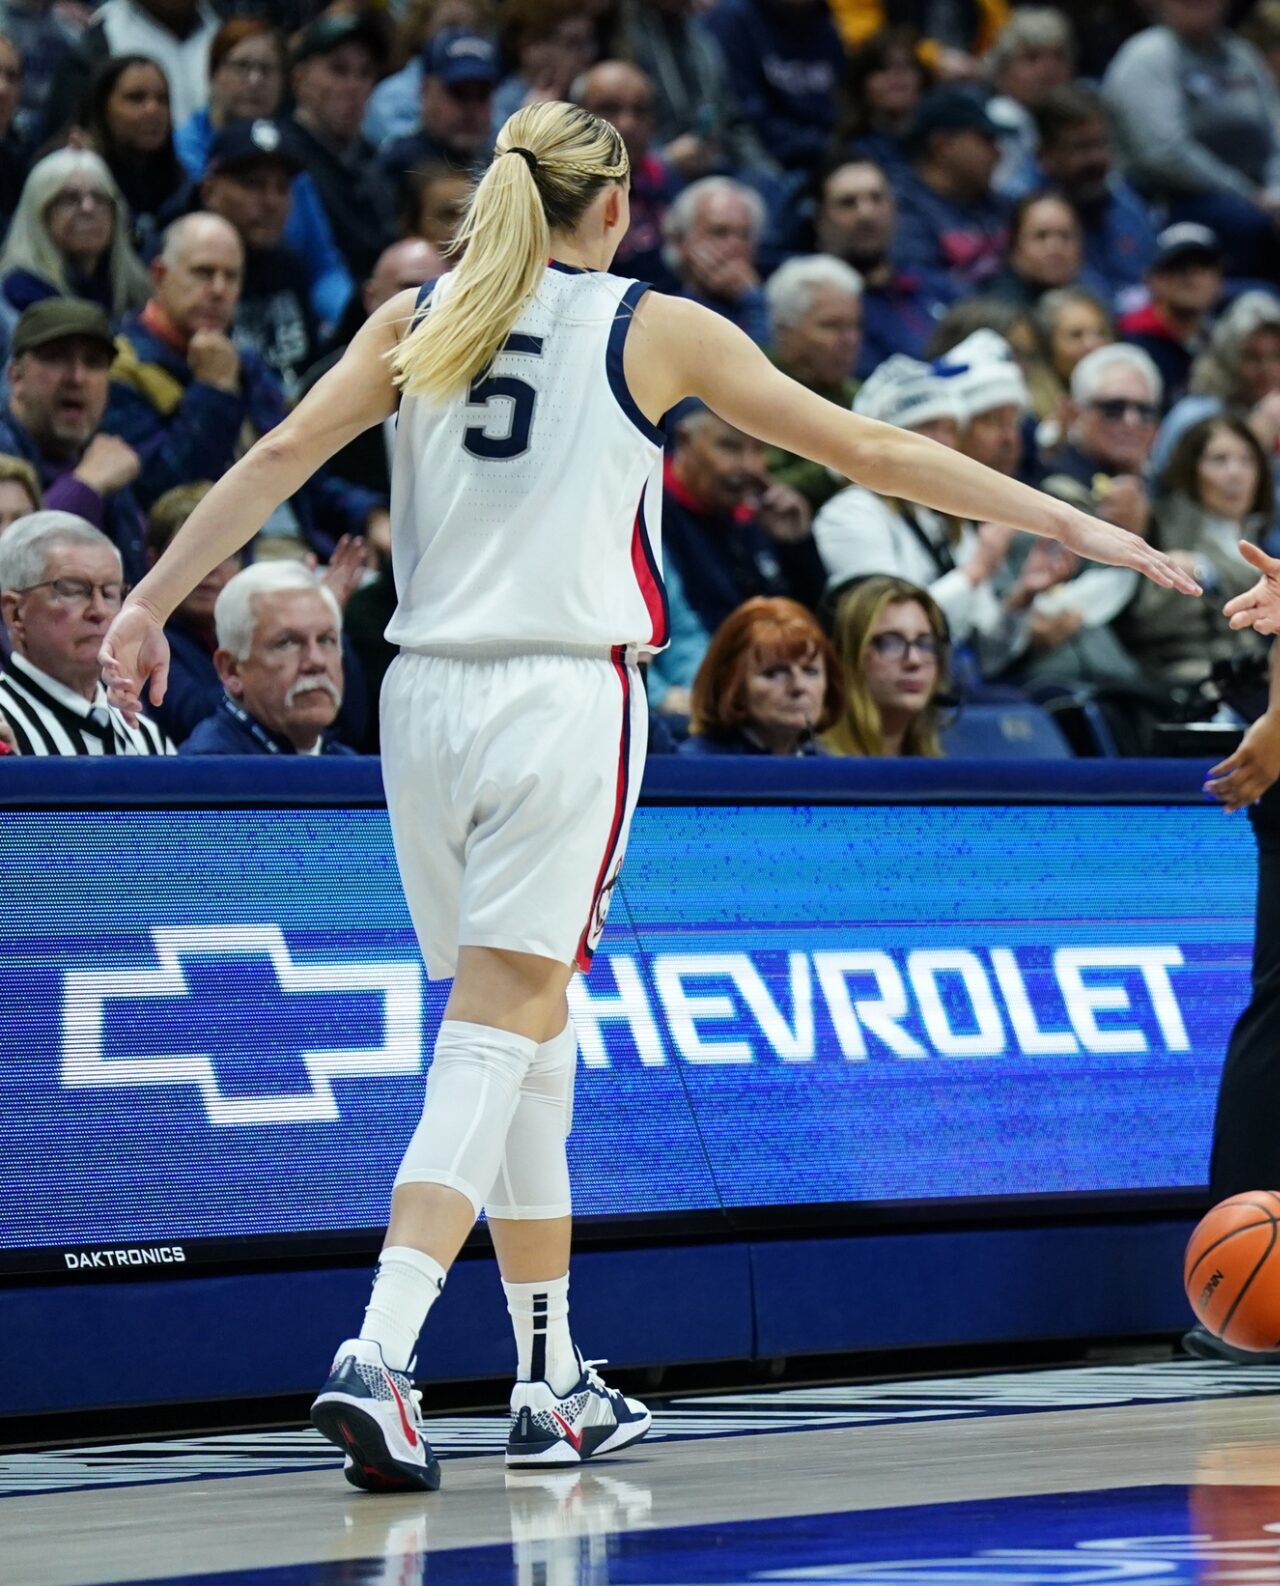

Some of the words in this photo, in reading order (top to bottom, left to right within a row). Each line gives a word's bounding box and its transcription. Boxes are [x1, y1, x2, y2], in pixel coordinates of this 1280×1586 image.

[461, 332, 543, 462] 5
[566, 945, 1192, 1067] HEVROLET
[64, 1246, 186, 1269] DAKTRONICS
